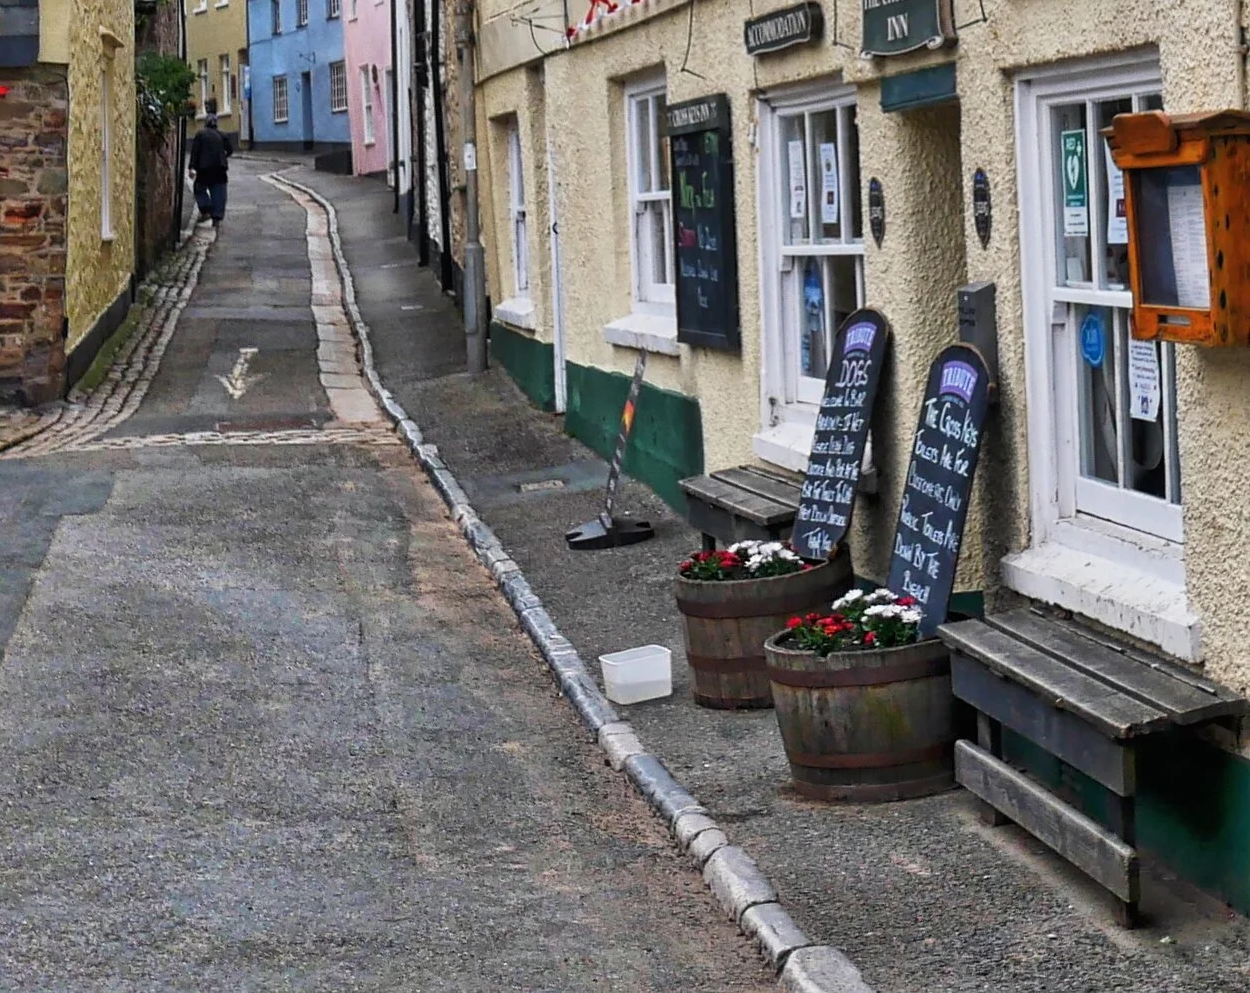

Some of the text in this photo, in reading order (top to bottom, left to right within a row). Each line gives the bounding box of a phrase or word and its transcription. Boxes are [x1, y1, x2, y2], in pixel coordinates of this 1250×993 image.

[748, 9, 806, 47] ACCOMMODATION
[887, 13, 909, 41] INN
[835, 360, 872, 387] DOGS
[942, 367, 976, 396] TRIBUTE
